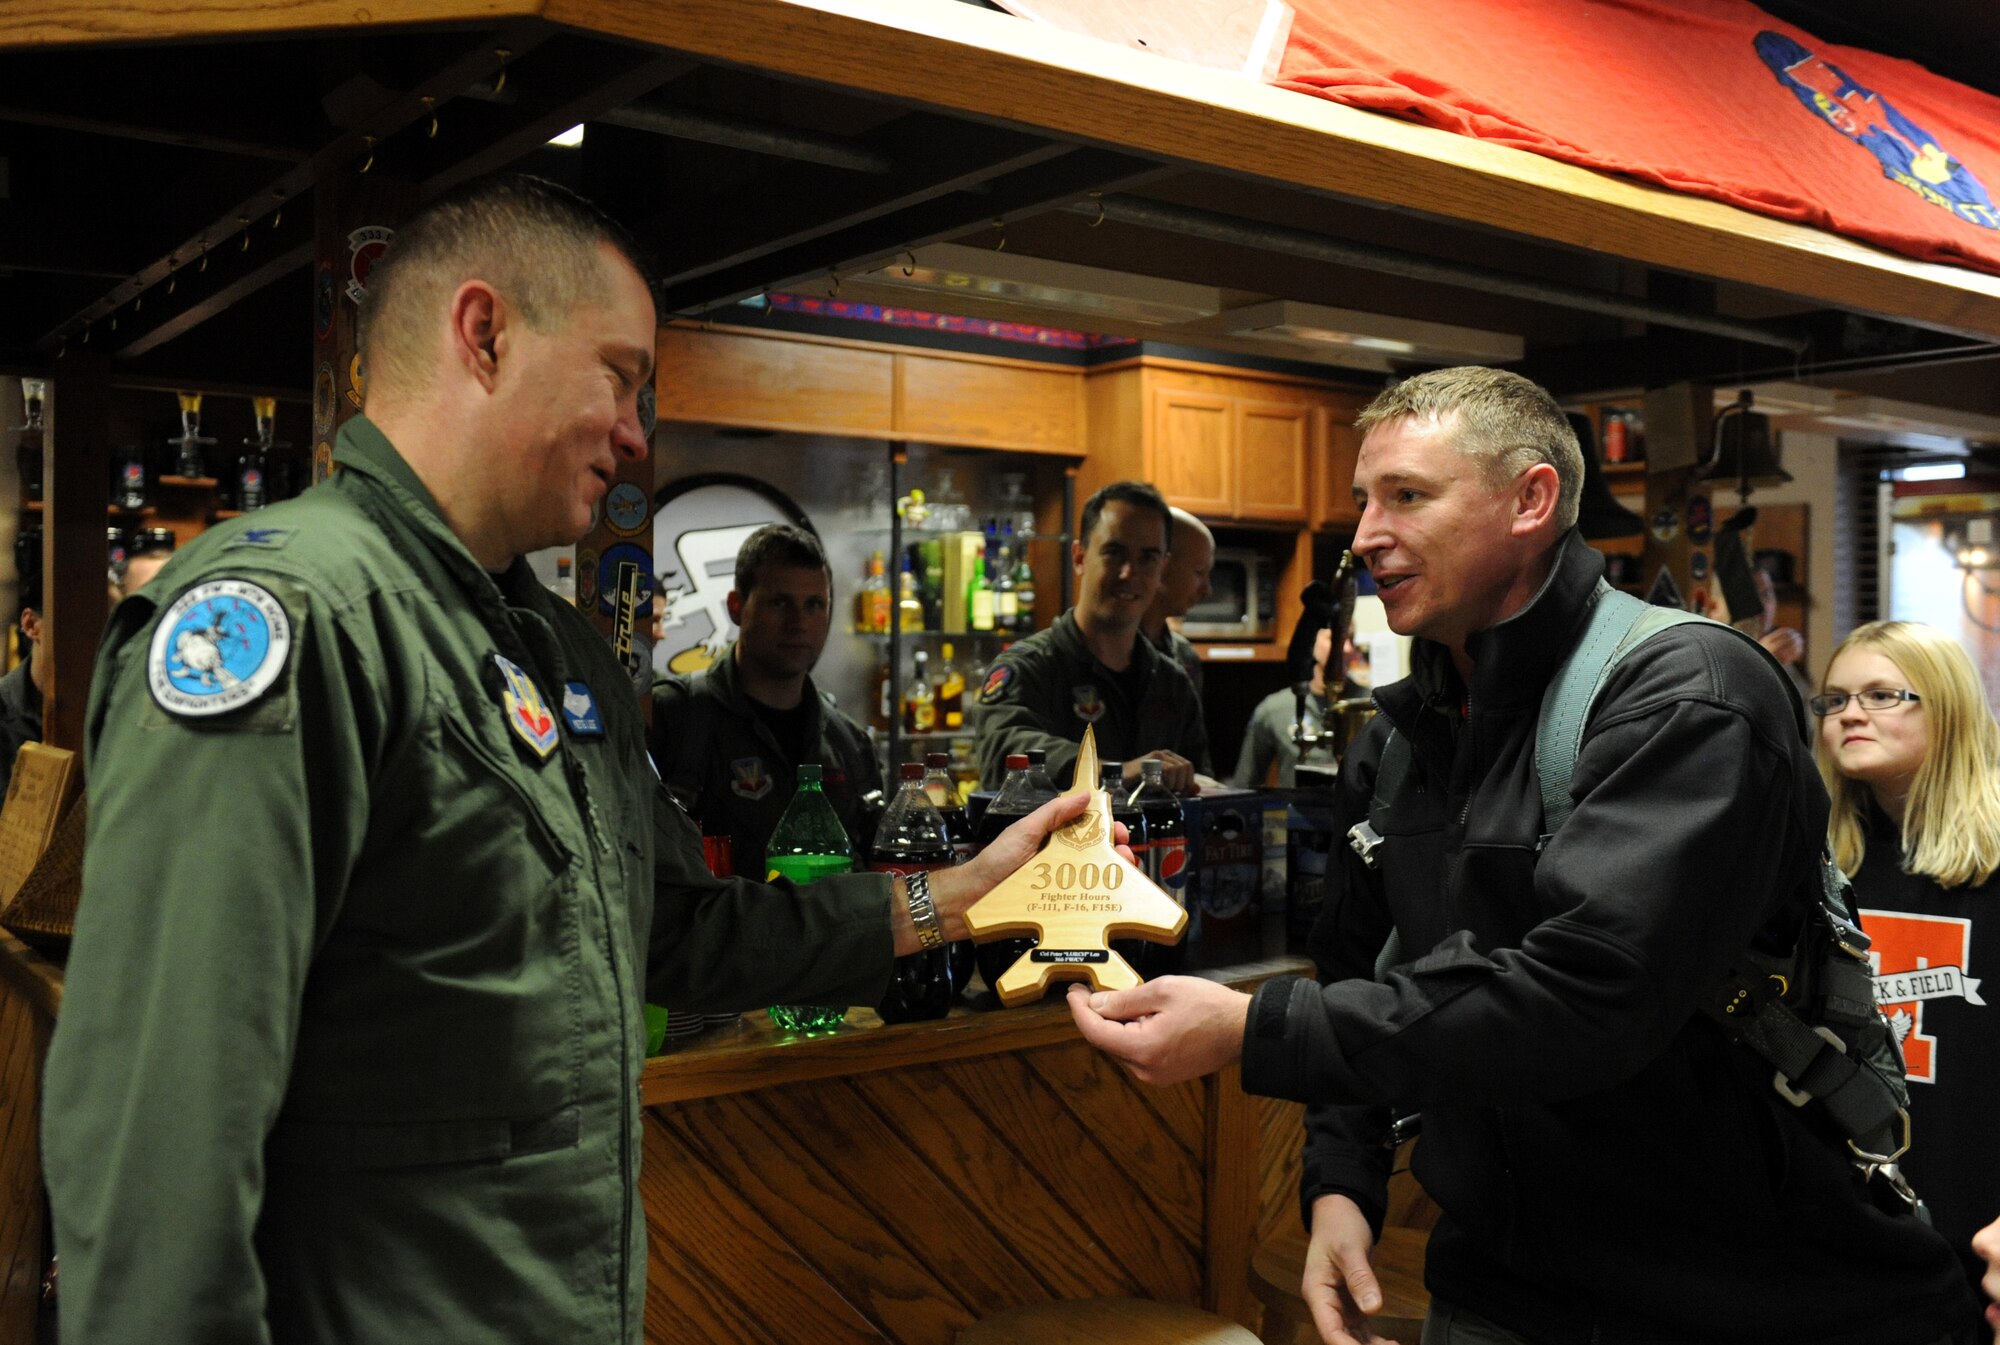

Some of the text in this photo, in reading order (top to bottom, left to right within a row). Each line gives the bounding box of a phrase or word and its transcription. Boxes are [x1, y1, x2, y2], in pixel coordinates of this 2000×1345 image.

[360, 230, 381, 241] 333
[1030, 862, 1124, 890] 3000
[1040, 892, 1111, 902] Fighter Hours
[1027, 903, 1123, 912] (F-111, F-16, F15E)
[1896, 979, 1907, 998] &
[1911, 972, 1954, 995] FIELD
